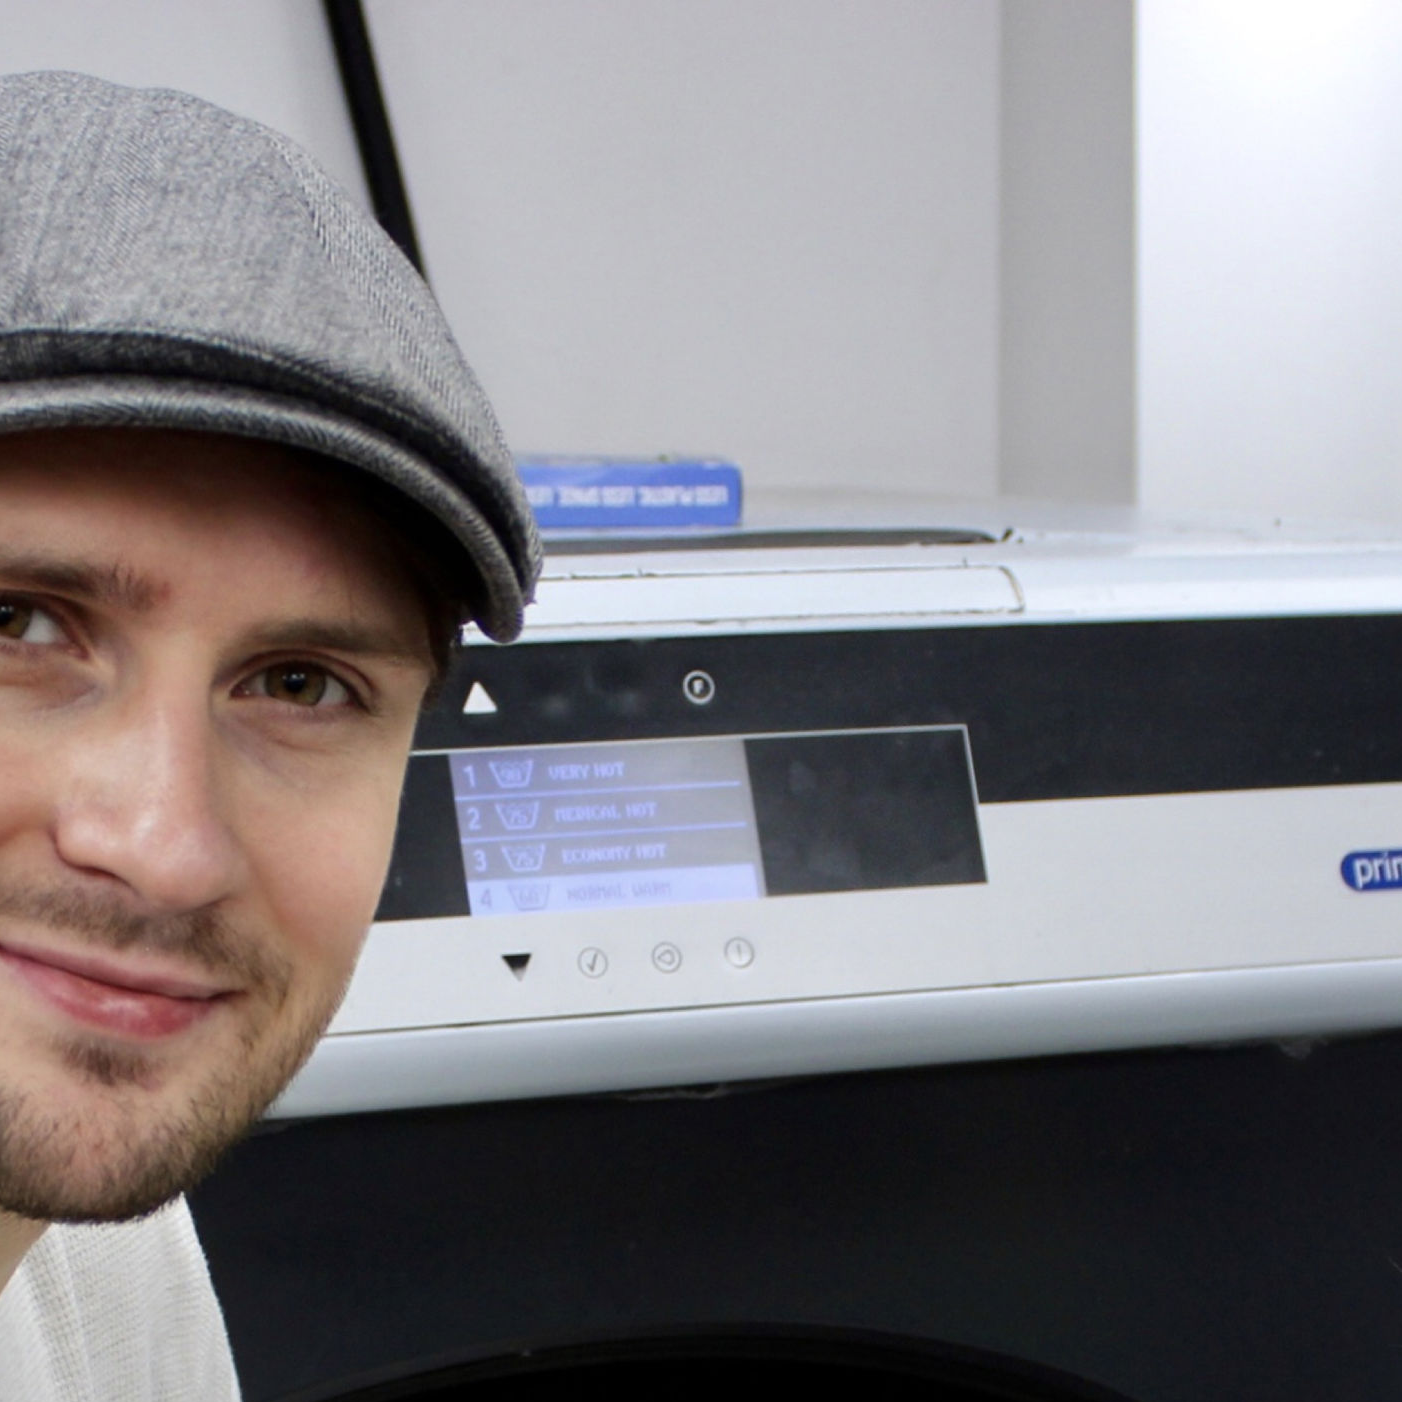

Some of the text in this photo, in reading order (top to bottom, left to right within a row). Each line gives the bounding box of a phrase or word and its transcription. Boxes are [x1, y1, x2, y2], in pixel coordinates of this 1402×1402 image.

[463, 765, 476, 787] 1
[548, 764, 589, 780] VERY
[594, 761, 625, 777] HOT
[467, 807, 482, 830] 2
[554, 804, 621, 822] MEDICAL
[626, 801, 657, 817] HOT
[473, 850, 487, 871] 3
[561, 846, 631, 864] ECONOMY
[636, 843, 667, 859] HOT
[480, 888, 493, 908] 4
